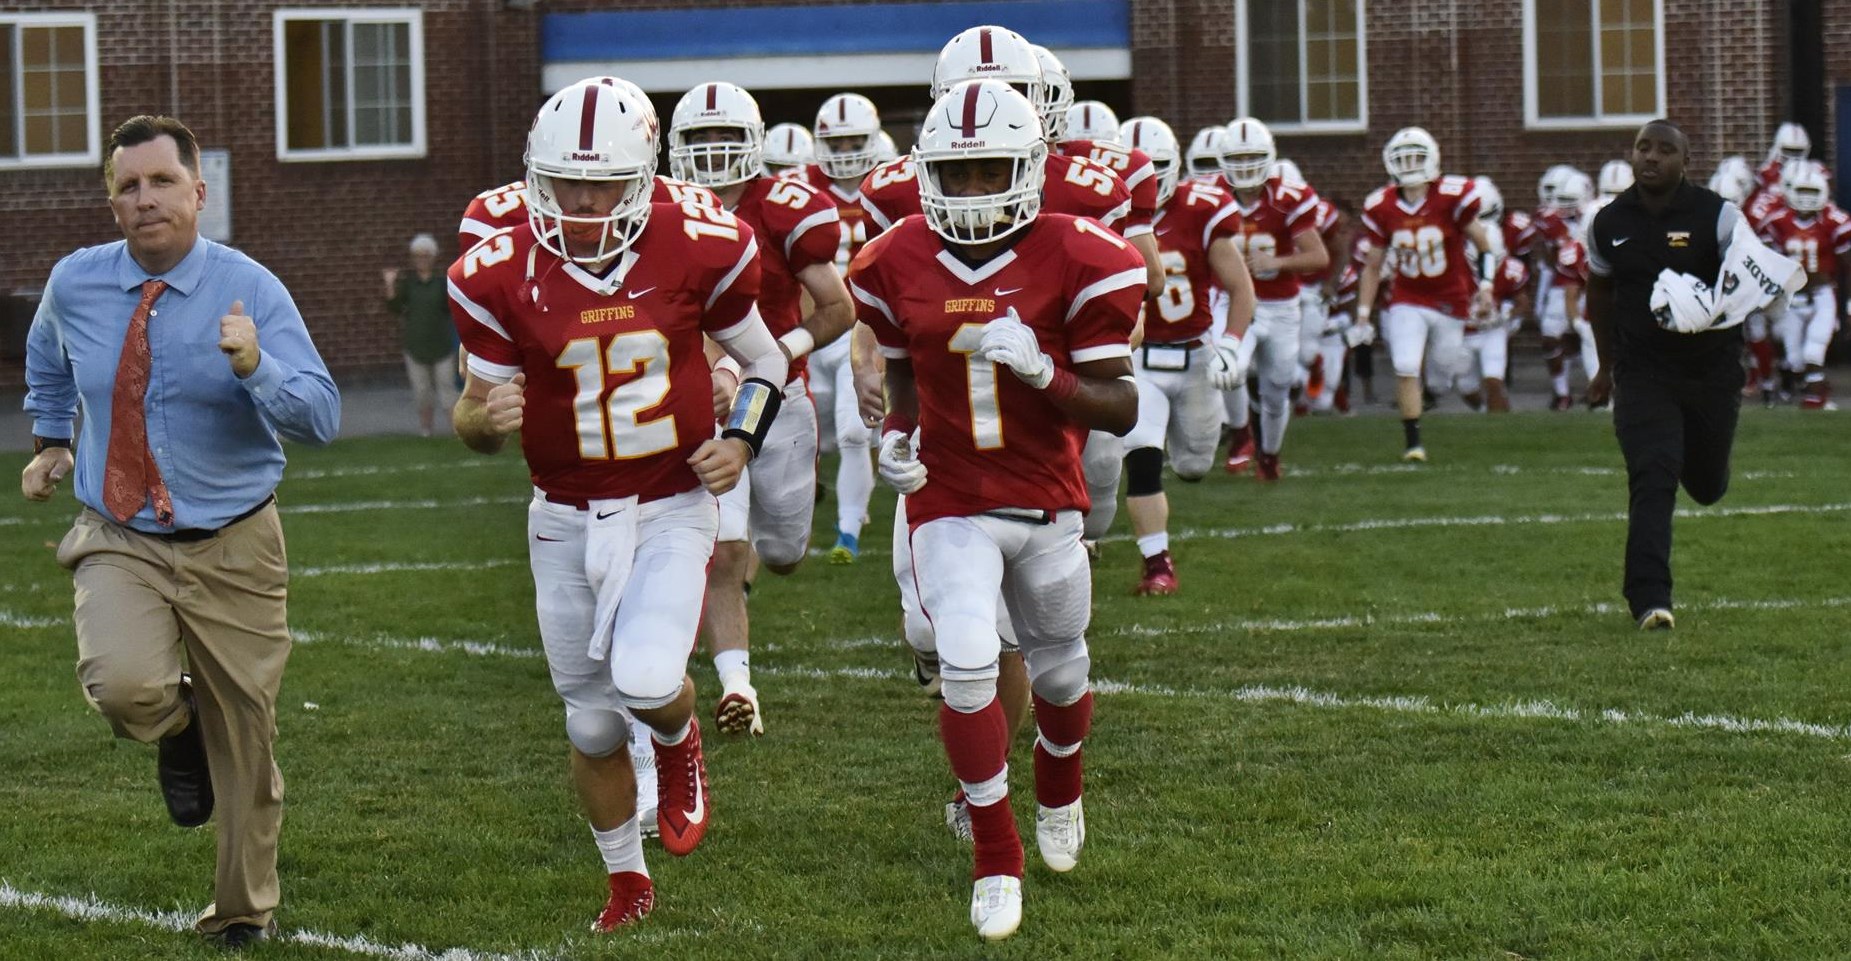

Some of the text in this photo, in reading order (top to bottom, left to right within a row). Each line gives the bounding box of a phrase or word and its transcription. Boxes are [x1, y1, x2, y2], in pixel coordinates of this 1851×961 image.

[976, 64, 1002, 73] Riddell
[951, 140, 986, 149] Riddell
[572, 153, 600, 161] Riddell
[681, 201, 740, 242] 12
[1072, 218, 1128, 250] 1
[580, 305, 635, 324] GRIFFINS
[944, 299, 996, 314] GRIFFINS
[554, 329, 680, 461] 12
[947, 322, 1006, 451] 1
